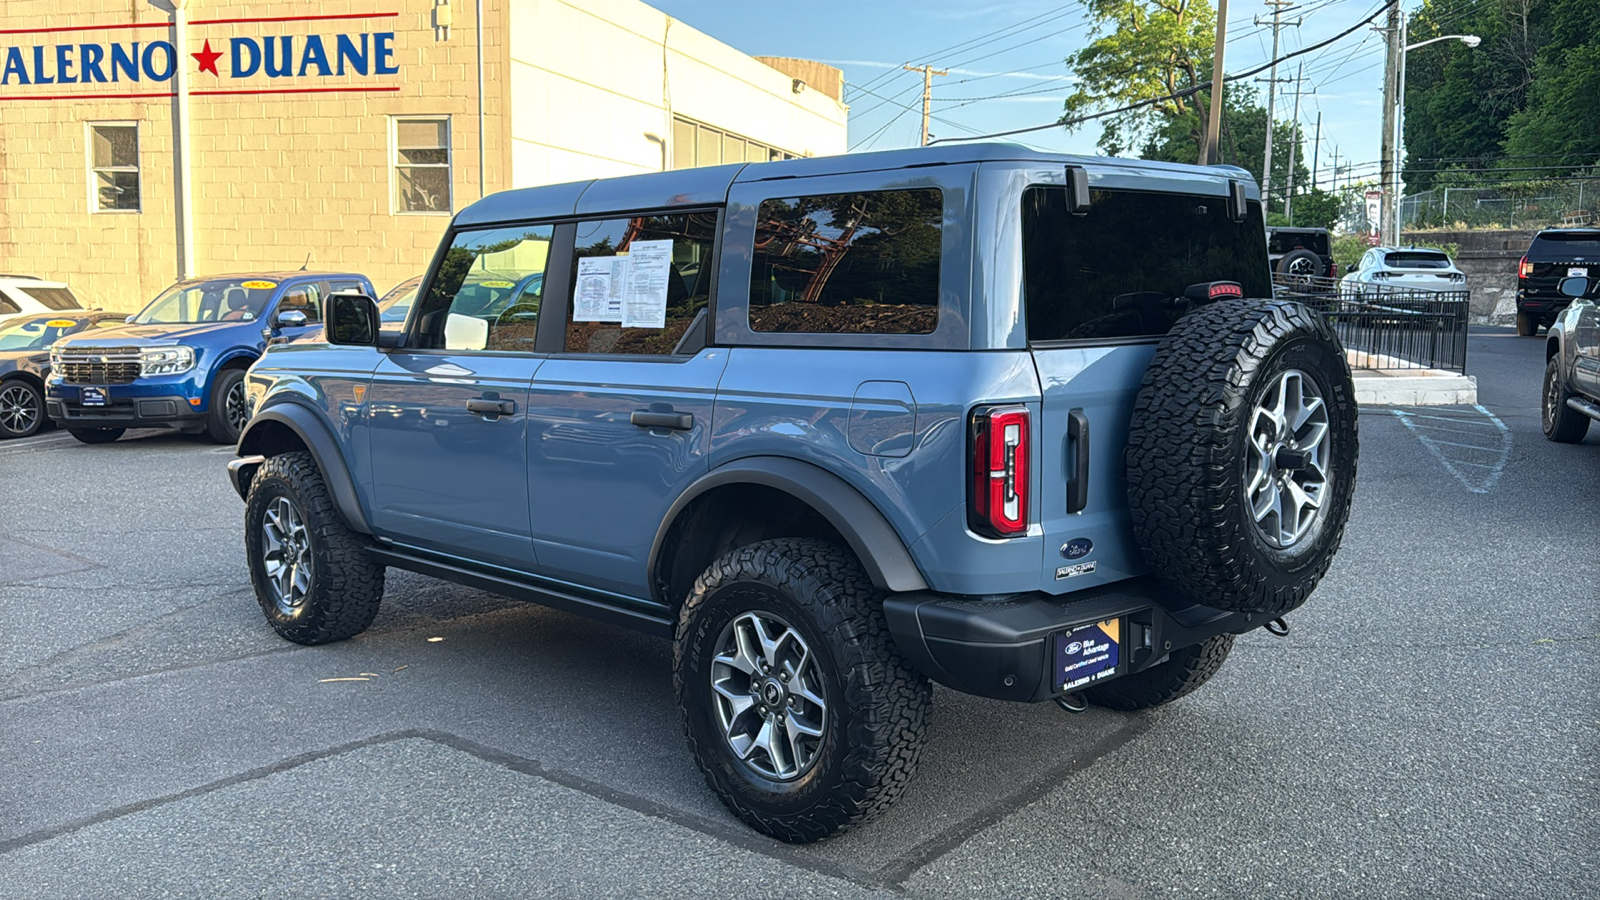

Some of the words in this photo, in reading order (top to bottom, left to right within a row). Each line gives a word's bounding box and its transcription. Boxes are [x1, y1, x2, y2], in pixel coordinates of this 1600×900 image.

[1, 40, 178, 85] ALERNO
[230, 32, 400, 78] DUANE
[1083, 640, 1095, 649] Blue
[1083, 643, 1110, 656] Advantage
[1063, 676, 1090, 690] SALERNO
[1097, 667, 1115, 679] DUANE
